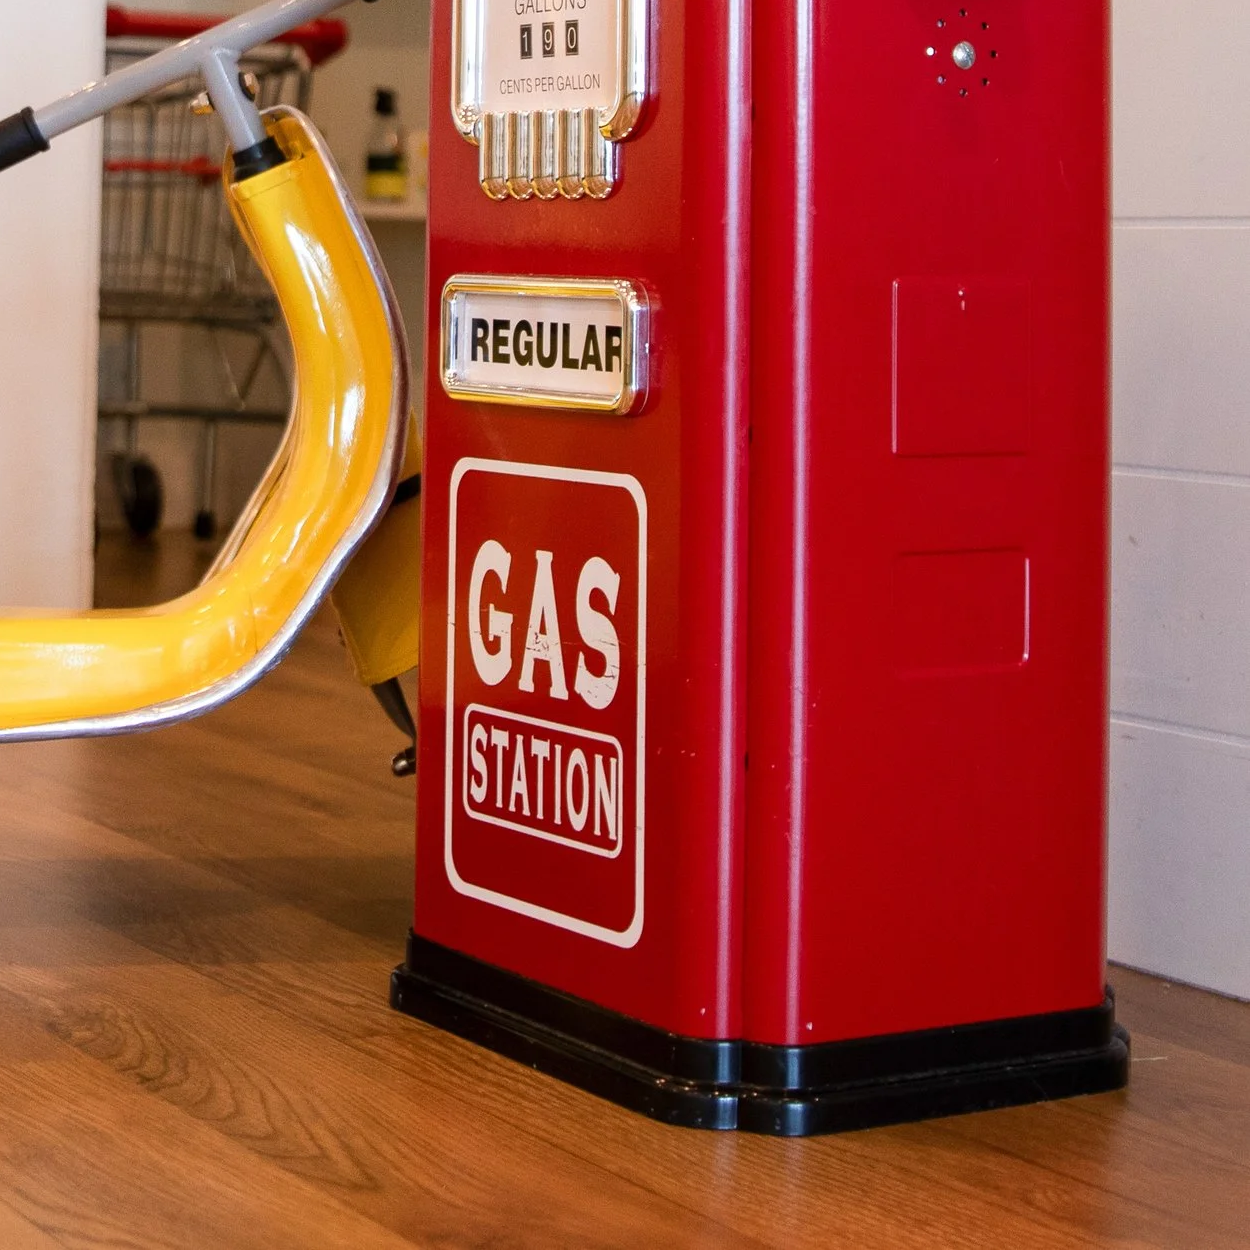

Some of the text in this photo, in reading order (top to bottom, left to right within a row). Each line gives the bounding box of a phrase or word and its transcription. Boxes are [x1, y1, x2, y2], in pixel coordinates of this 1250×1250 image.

[500, 73, 601, 95] CENTS PER GALLON
[471, 317, 623, 374] REGULAR
[468, 539, 621, 710] GAS
[470, 723, 617, 840] STATION
